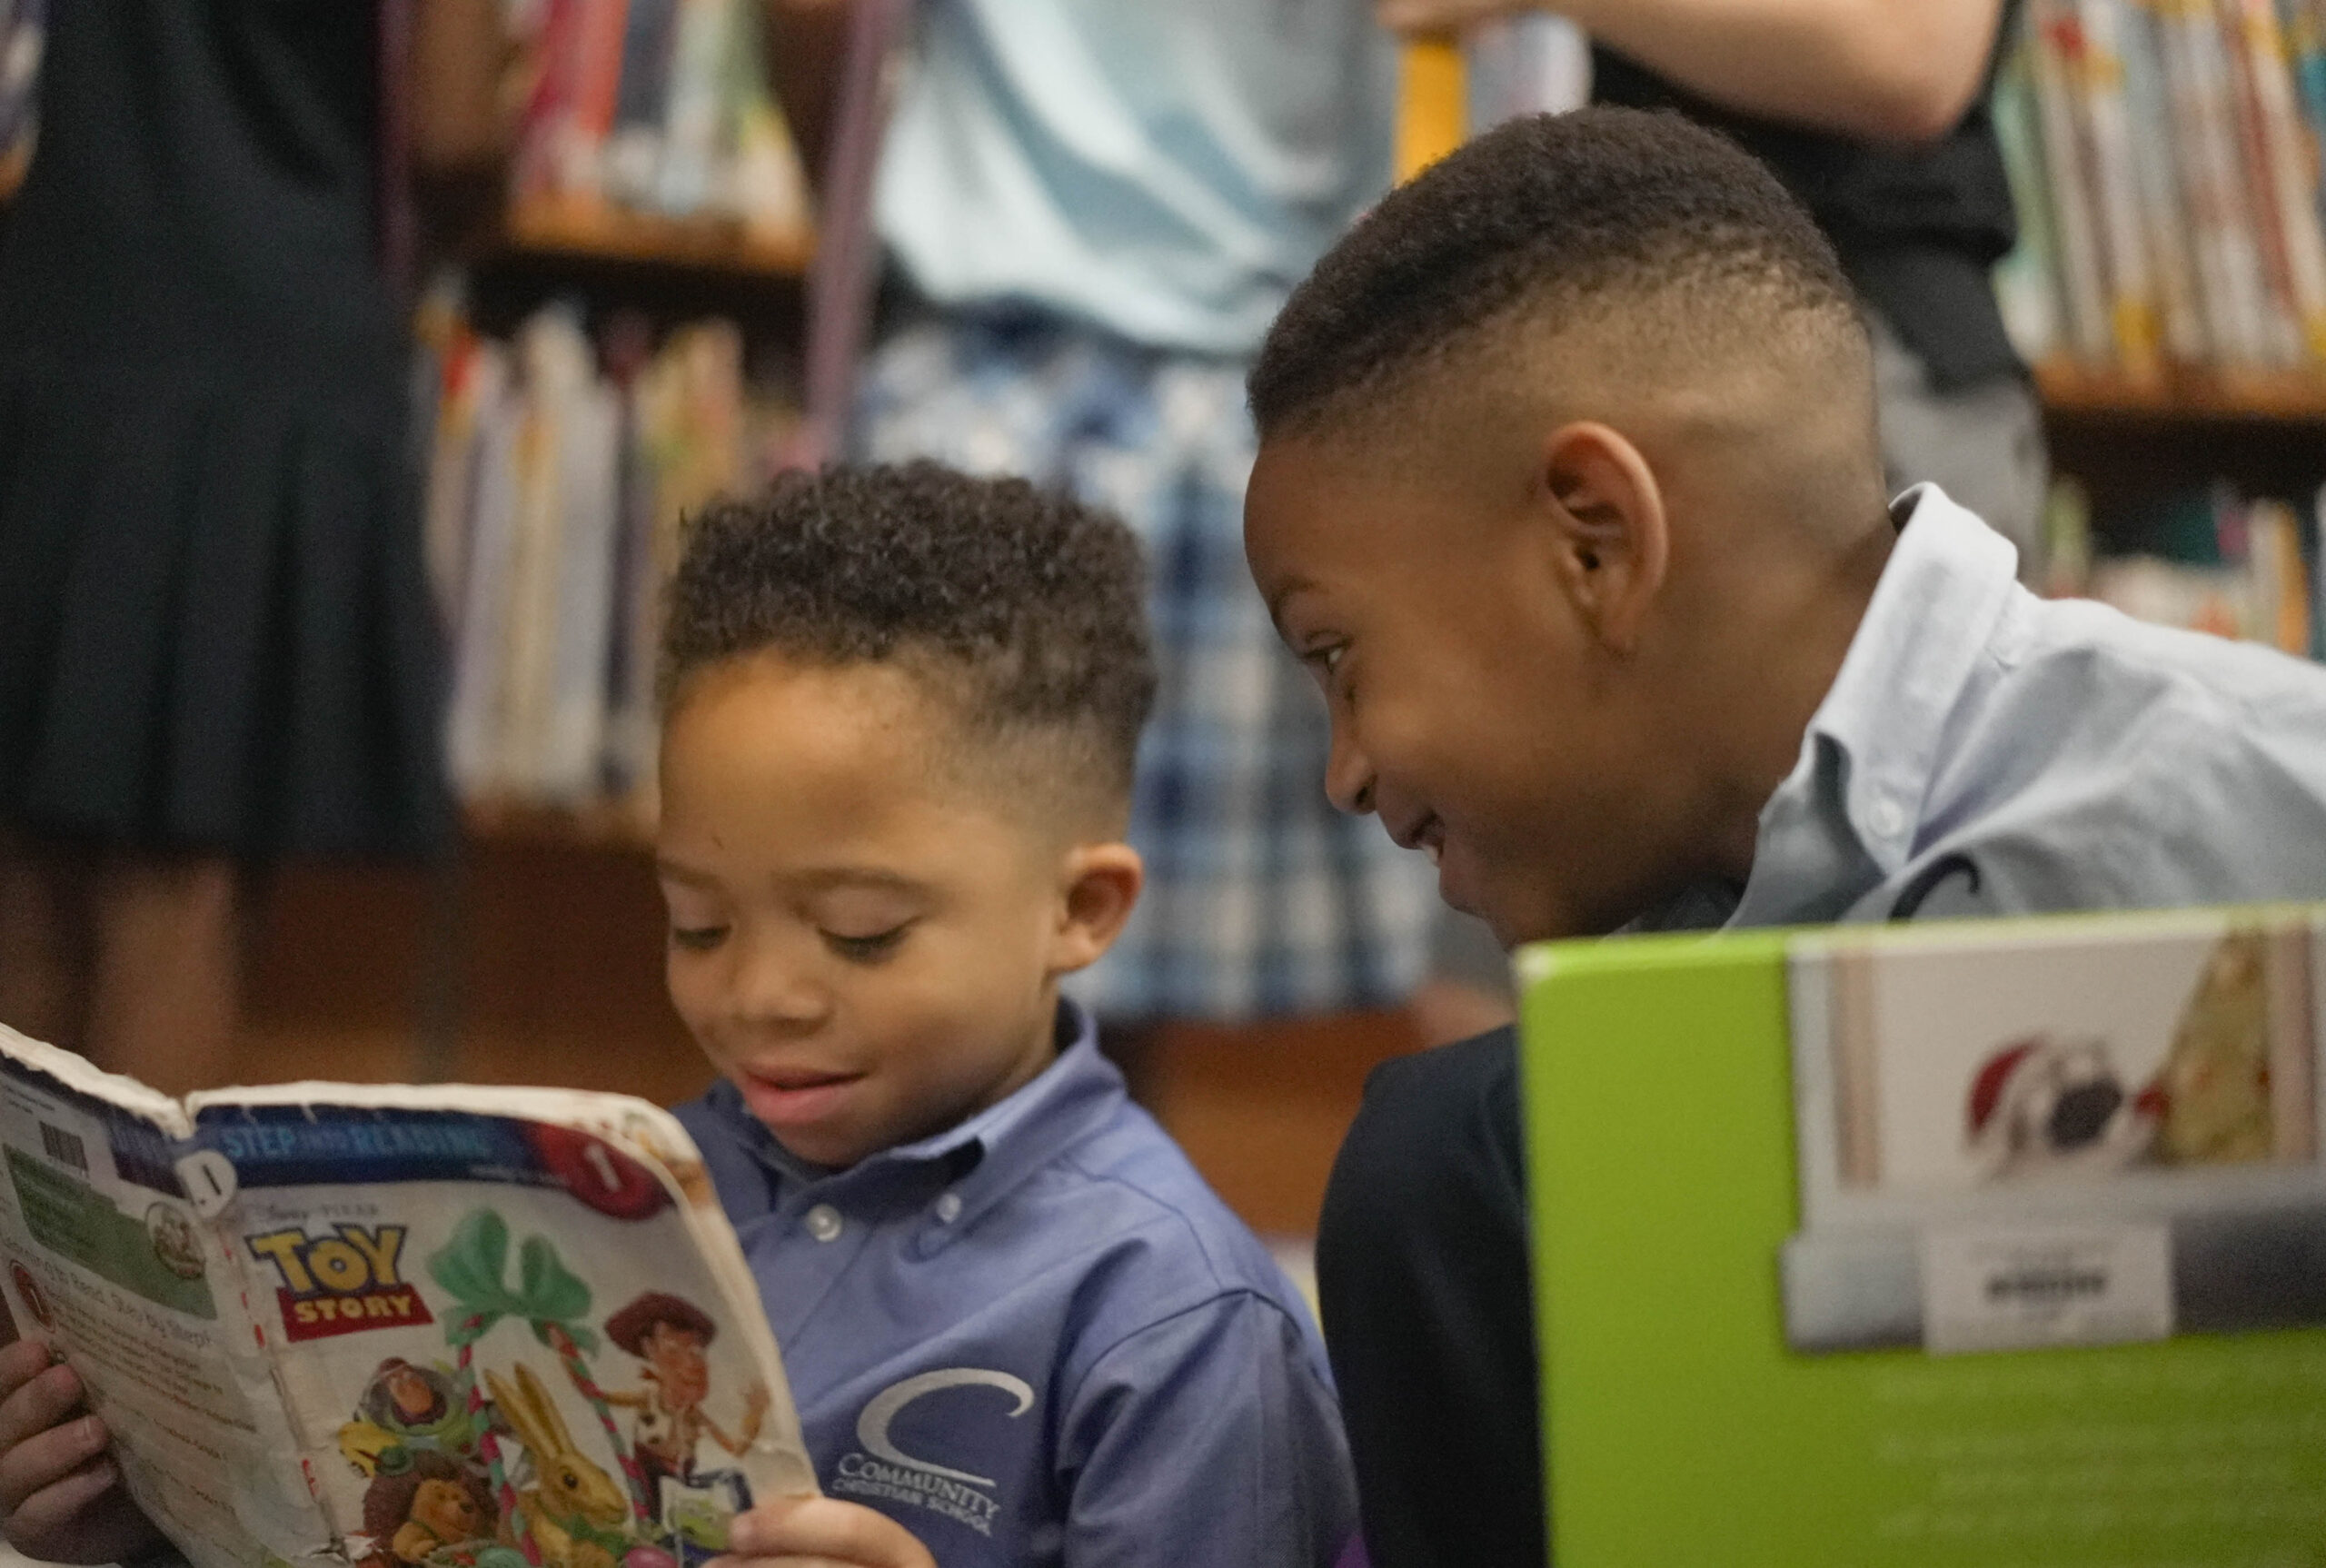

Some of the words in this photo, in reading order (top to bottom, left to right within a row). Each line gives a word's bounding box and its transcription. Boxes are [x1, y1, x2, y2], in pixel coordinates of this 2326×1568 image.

[222, 1126, 296, 1159] STEP
[245, 1224, 406, 1297] TOY
[293, 1295, 413, 1324] STORY
[838, 1453, 1000, 1520] COMMUNITY
